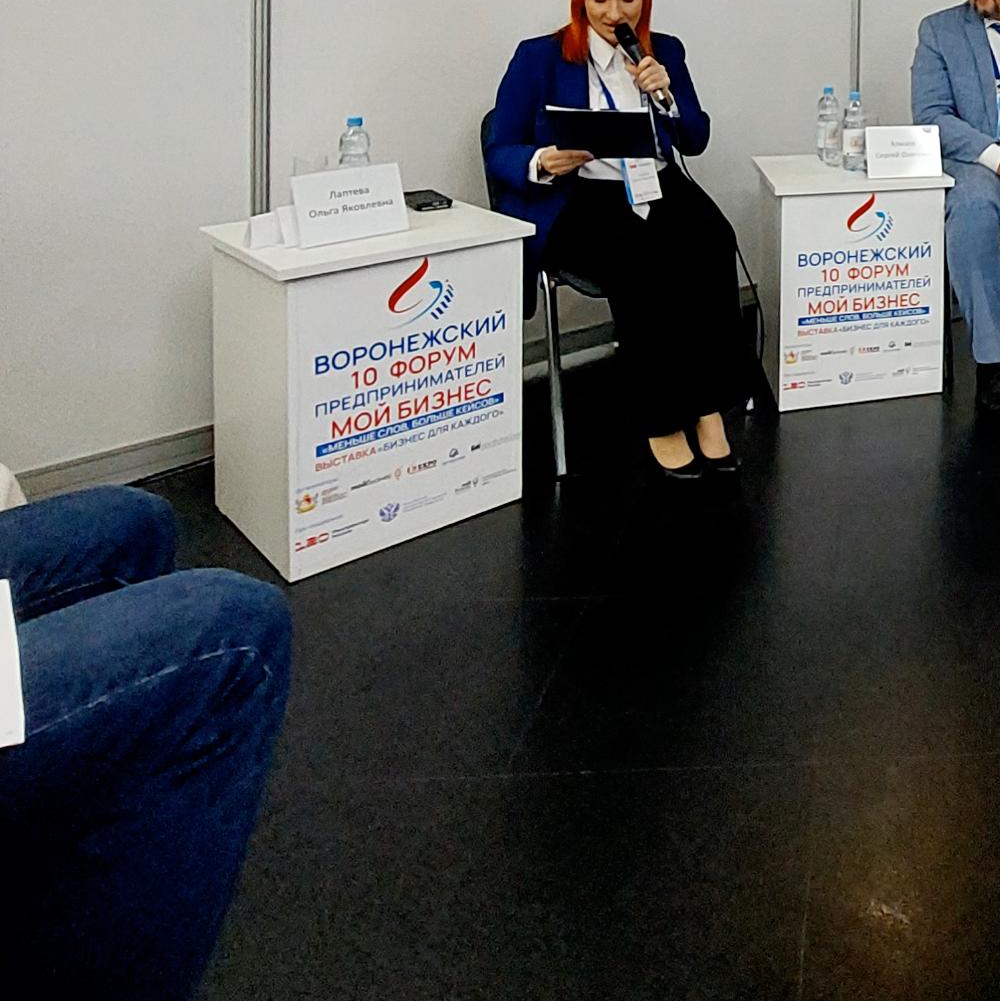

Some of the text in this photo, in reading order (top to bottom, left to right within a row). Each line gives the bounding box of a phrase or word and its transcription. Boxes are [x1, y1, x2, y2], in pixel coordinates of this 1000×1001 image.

[308, 207, 340, 218] Ольга
[797, 241, 932, 268] ВОРОНЕЖСКИЙ
[821, 263, 910, 283] 10 ФОРУМ
[797, 275, 931, 298] ПРЕДПРИНИМАТЕЛЕЙ
[808, 292, 921, 316] МОЙ БИЗНЕС
[314, 309, 507, 376] ВОРОНЕЖСКИЙ
[351, 341, 477, 390] 10 ФОРУМ
[314, 353, 506, 418] ПРЕДПРИНИМАТЕЛЕЙ
[331, 378, 493, 439] МОЙ БИЗНЕС
[314, 446, 377, 472] ВЫСТАВКА
[427, 423, 450, 440] ДЛЯ
